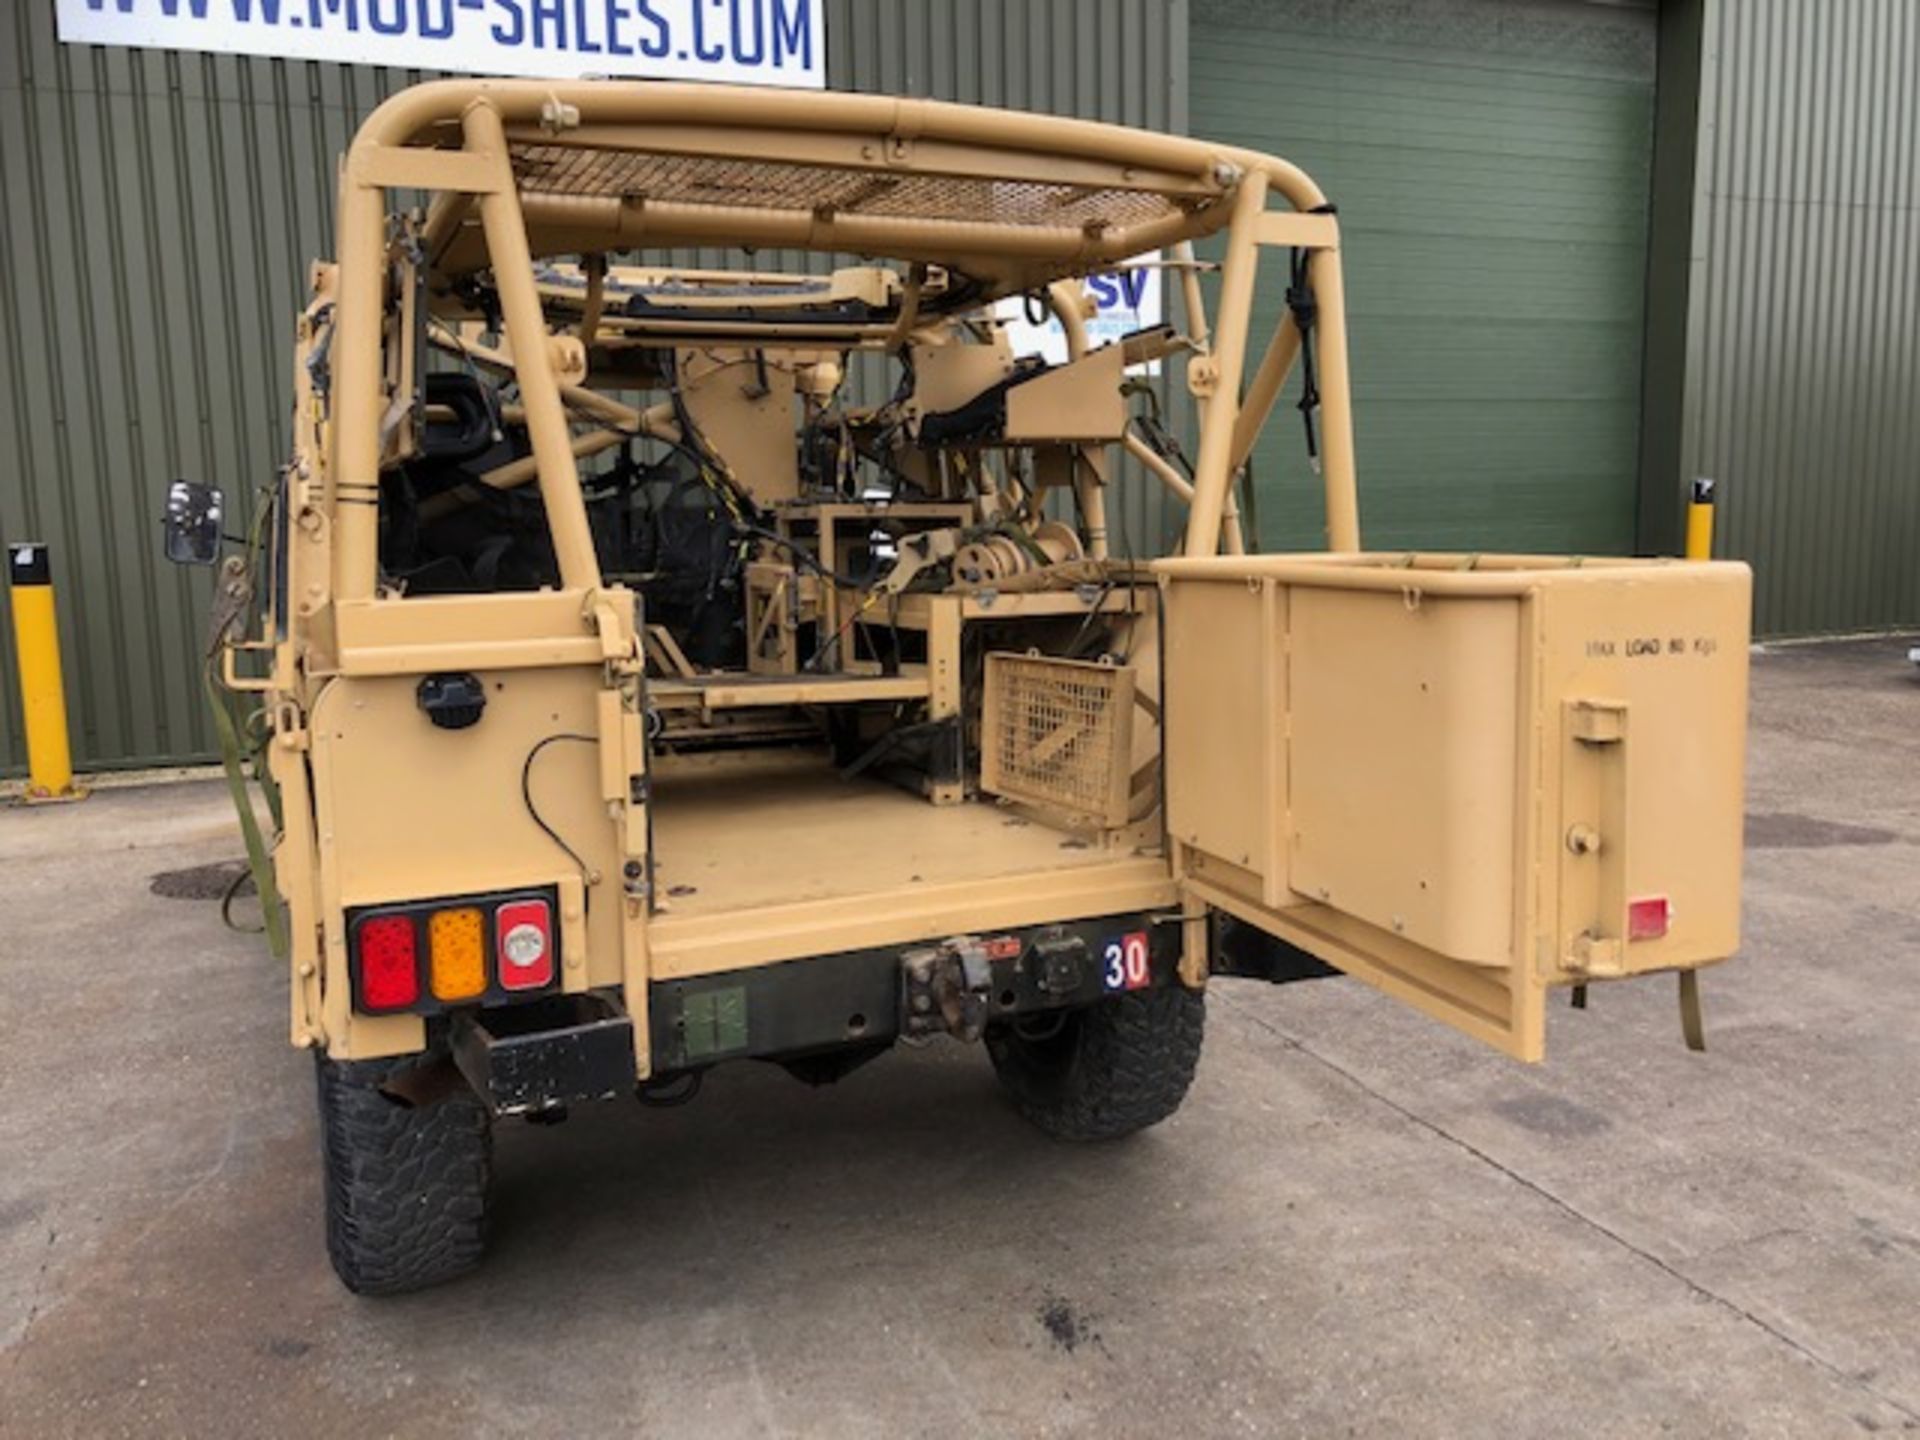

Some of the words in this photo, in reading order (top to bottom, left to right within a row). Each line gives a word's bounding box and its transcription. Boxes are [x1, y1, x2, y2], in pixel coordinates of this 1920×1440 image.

[86, 0, 812, 70] .D-SALES.COM
[1625, 638, 1661, 658] LOAD
[1104, 939, 1146, 988] 30
